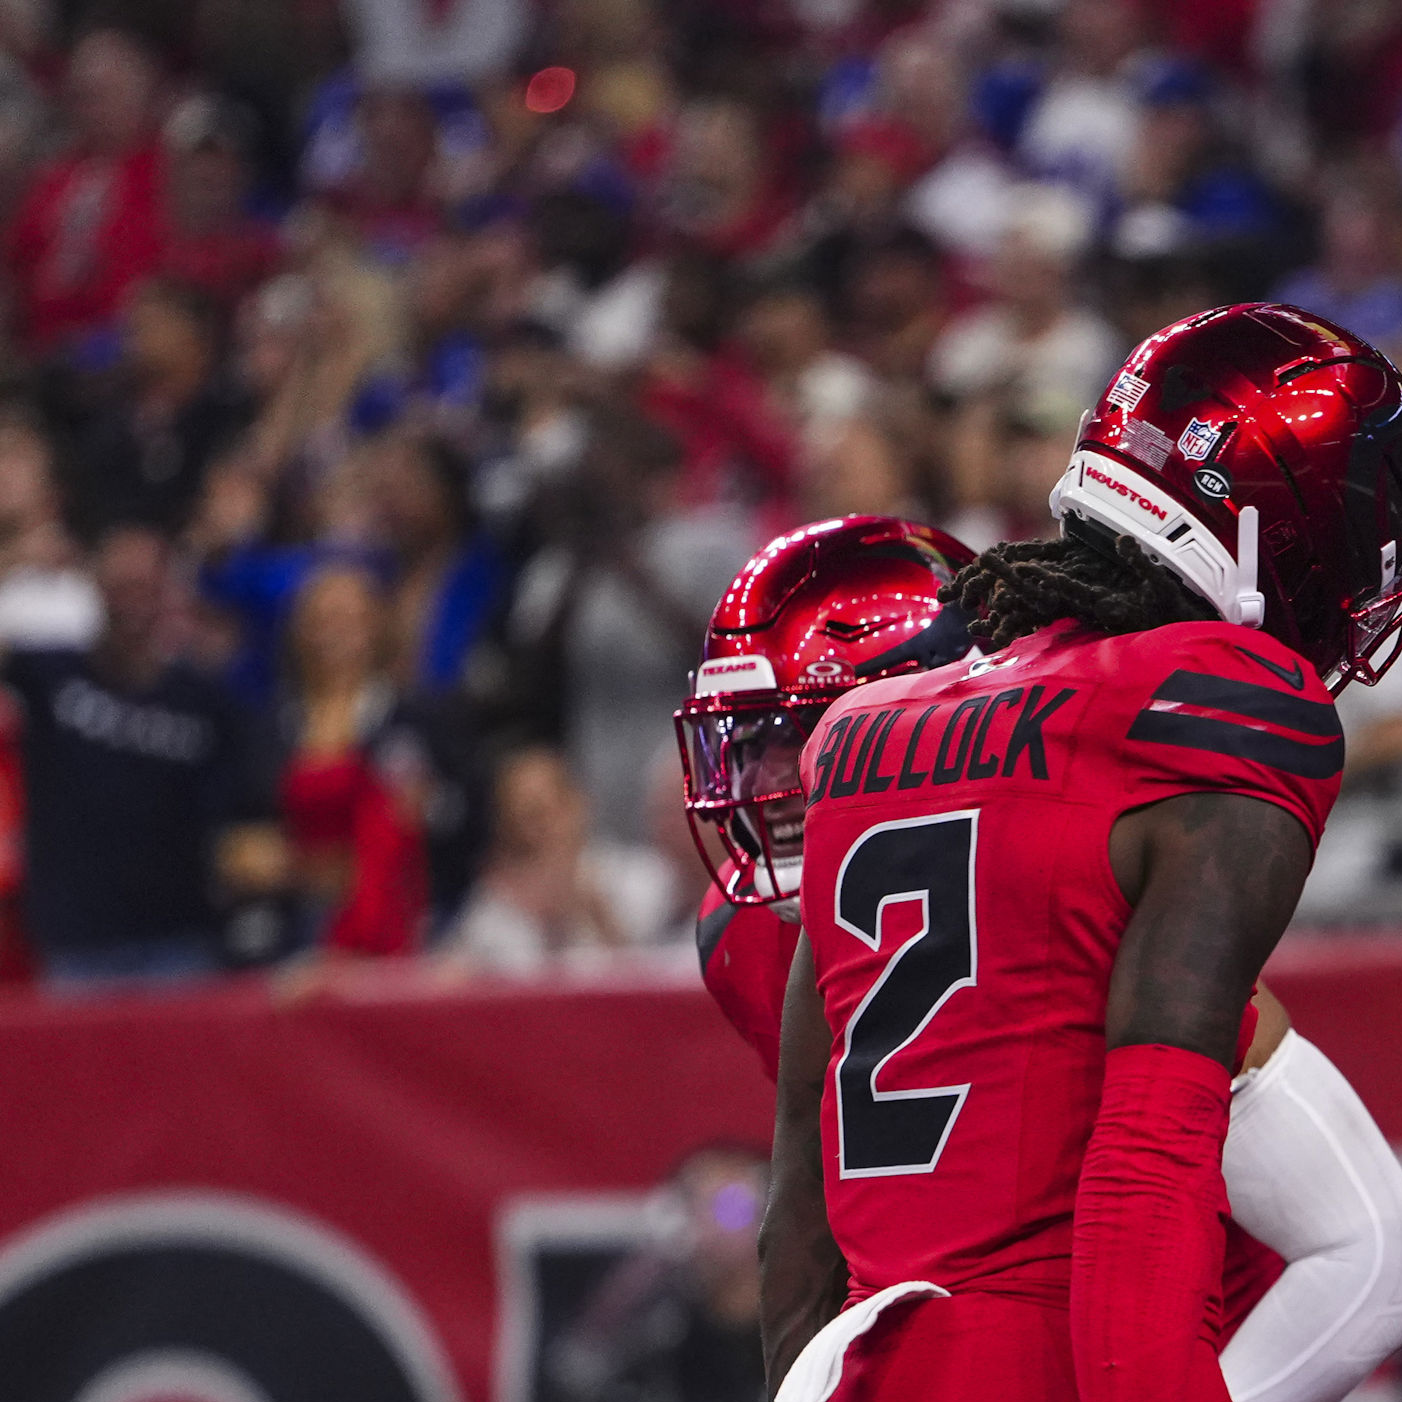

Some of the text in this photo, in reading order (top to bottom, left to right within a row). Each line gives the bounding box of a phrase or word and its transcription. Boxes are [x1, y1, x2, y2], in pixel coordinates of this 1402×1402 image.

[1086, 466, 1168, 521] HOUSTON
[702, 662, 757, 677] TEXANS
[805, 685, 1078, 811] BULLOCK
[834, 808, 981, 1180] 2
